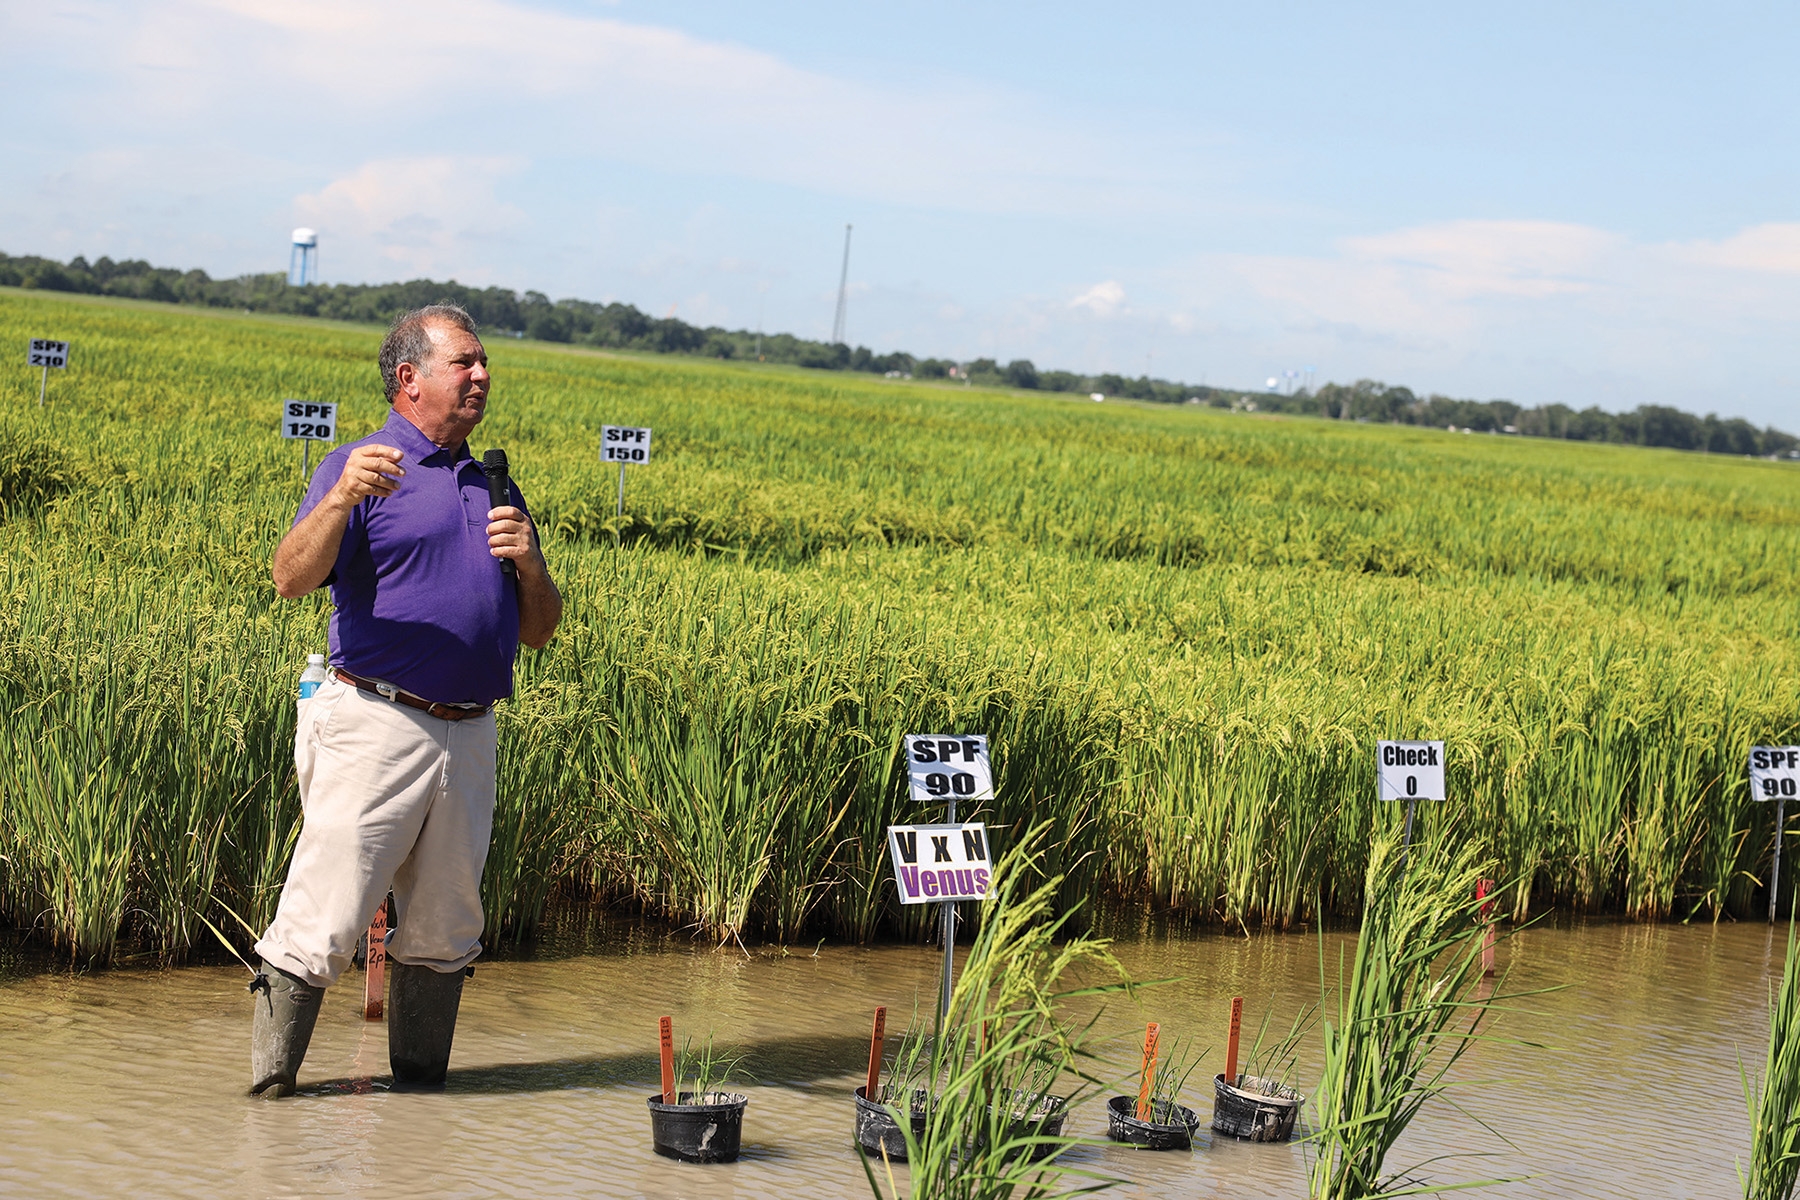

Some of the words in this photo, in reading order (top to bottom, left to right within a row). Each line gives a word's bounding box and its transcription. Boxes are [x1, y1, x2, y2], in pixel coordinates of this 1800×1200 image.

[33, 340, 66, 353] SPF
[32, 354, 64, 366] 210
[288, 403, 332, 419] SPF
[287, 422, 331, 438] 120
[606, 429, 646, 443] SPF
[605, 447, 645, 461] 150
[912, 740, 980, 763] SPF
[1383, 745, 1439, 767] Check
[1753, 750, 1799, 769] SPF
[925, 772, 976, 796] 90
[1406, 775, 1417, 797] 0
[1762, 777, 1797, 797] 90
[894, 831, 917, 864] V
[962, 830, 986, 862] N
[900, 866, 989, 898] Venus
